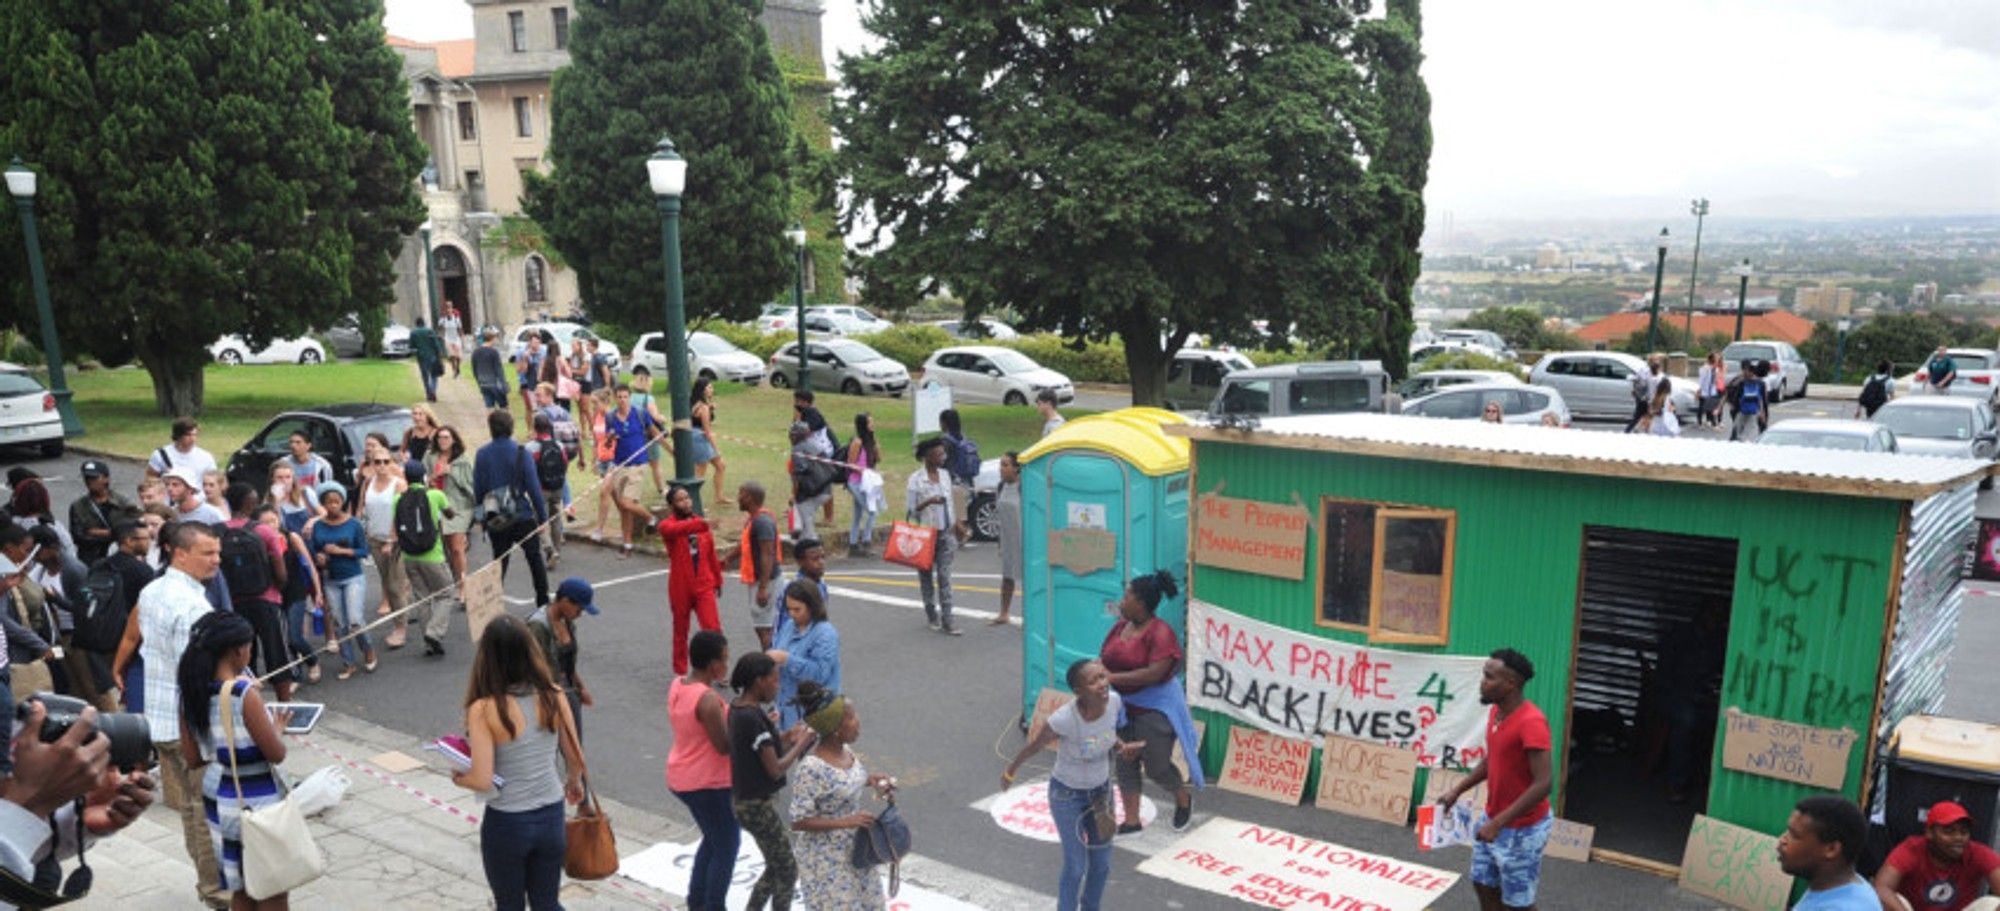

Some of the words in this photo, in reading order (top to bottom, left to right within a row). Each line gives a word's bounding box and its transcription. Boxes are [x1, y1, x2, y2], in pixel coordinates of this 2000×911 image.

[1198, 527, 1304, 561] MANAGEMENT
[1749, 545, 1877, 618] UCT
[1206, 617, 1275, 672] MAX
[1416, 672, 1455, 715] 4
[1201, 661, 1310, 733] BLACK
[1232, 727, 1269, 752] WE
[1730, 715, 1760, 733] THE
[1768, 723, 1821, 745] STATE
[1746, 752, 1814, 779] NATION
[1238, 823, 1451, 890] NATIONALIZE
[1283, 859, 1331, 878] FOR
[1174, 849, 1244, 877] FREE
[1248, 873, 1394, 911] EDUCATIO
[1231, 884, 1297, 908] NOW
